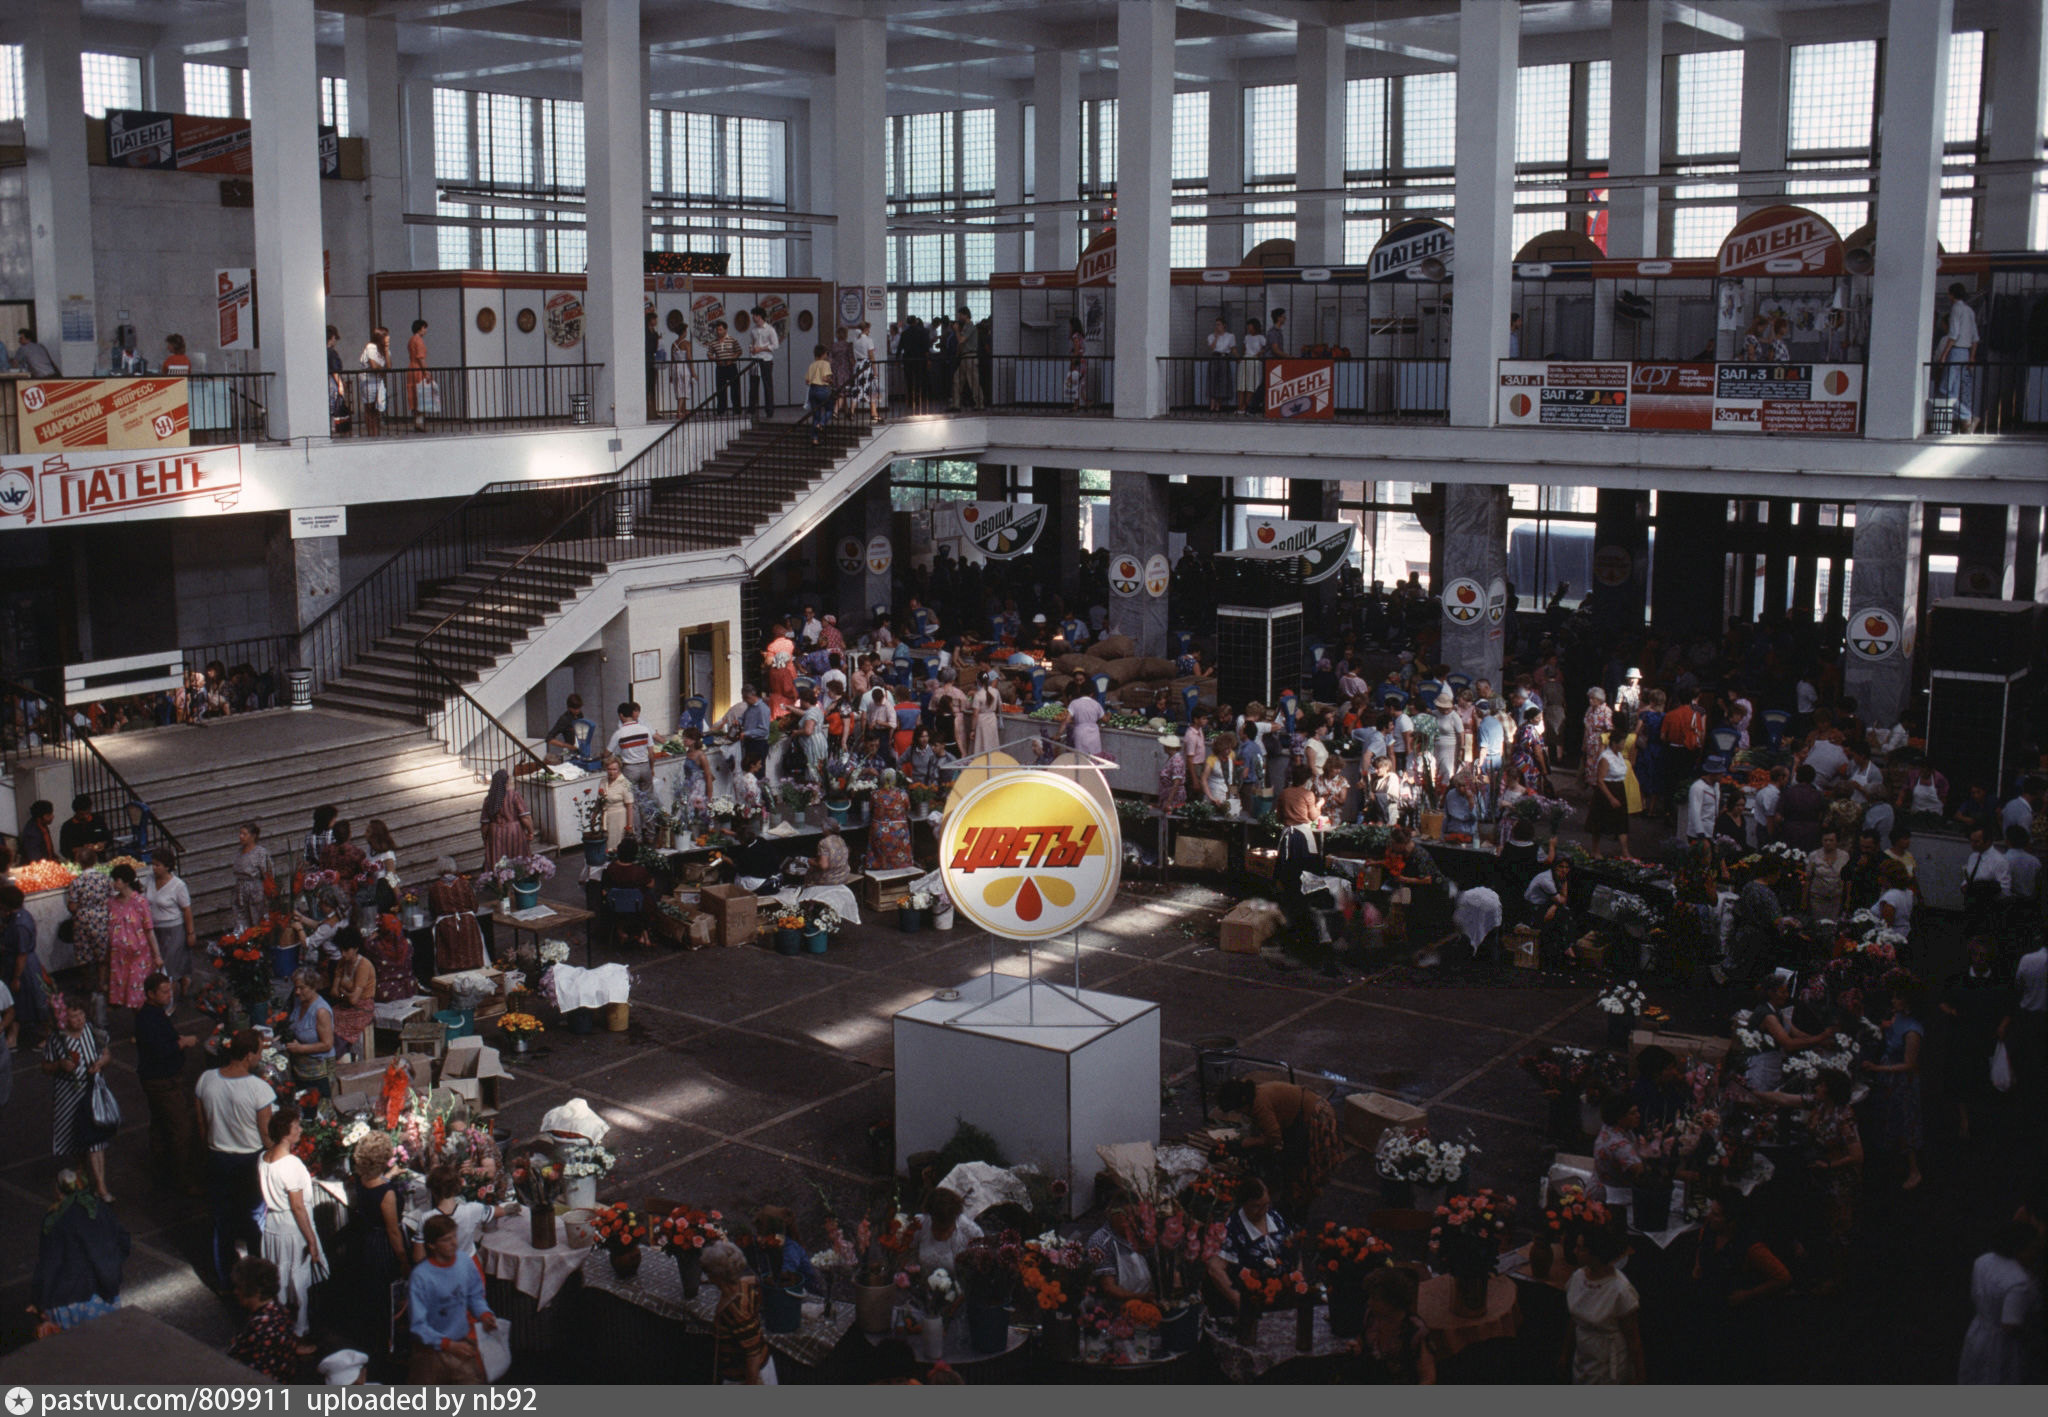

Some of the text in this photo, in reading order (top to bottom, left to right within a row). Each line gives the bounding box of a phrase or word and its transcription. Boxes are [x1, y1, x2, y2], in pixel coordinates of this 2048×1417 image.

[1505, 375, 1528, 385] ЗАЛ
[1721, 368, 1747, 380] ЗАЛ
[1542, 389, 1566, 400] ЗАЛ
[975, 504, 1014, 541] ОВОЩИ
[1271, 524, 1317, 552] ВОЩИ
[950, 825, 1098, 874] ЦВЕТЫ
